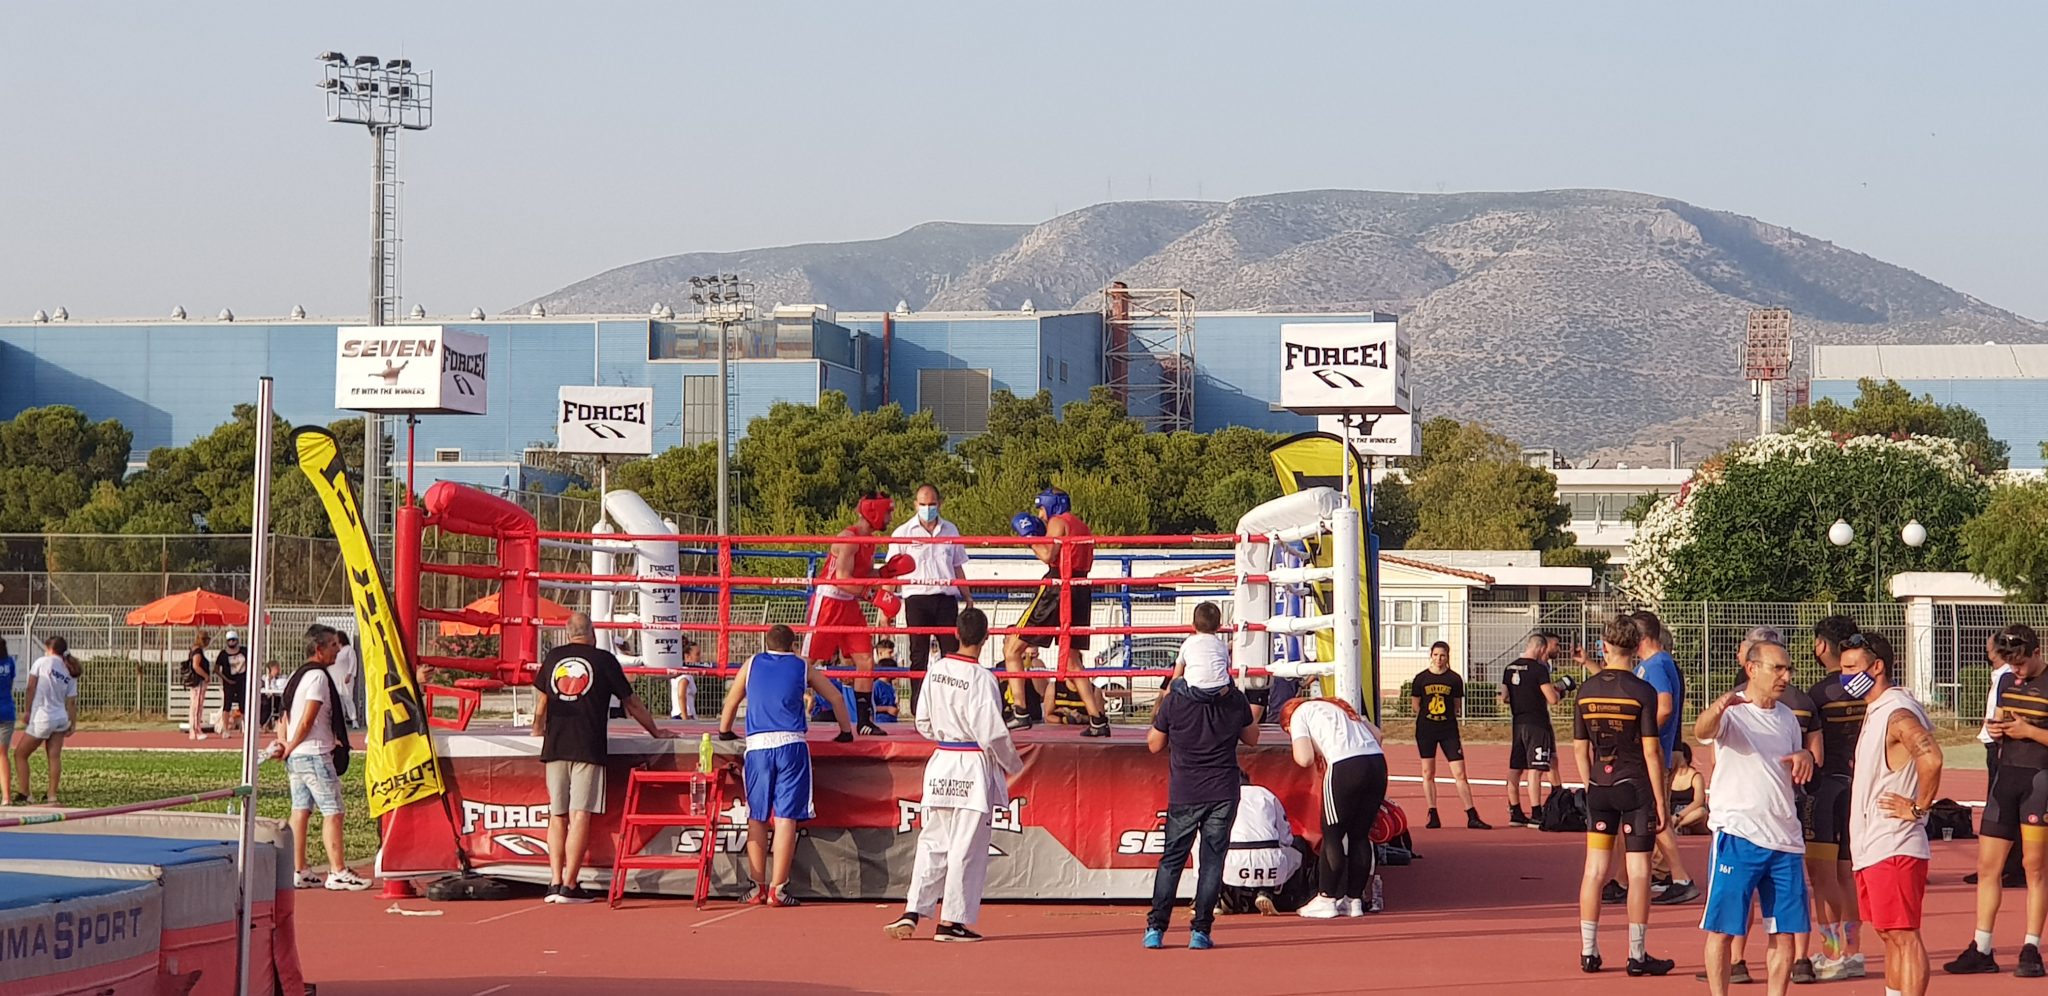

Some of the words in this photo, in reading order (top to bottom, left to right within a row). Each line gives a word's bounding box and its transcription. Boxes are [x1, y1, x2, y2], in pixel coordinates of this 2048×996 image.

[342, 339, 436, 357] SEVEN
[1285, 341, 1388, 370] FORCE1
[442, 344, 486, 380] FORCE1
[563, 400, 645, 425] FORCE1
[461, 799, 550, 836] FORC
[1238, 867, 1278, 880] GRE
